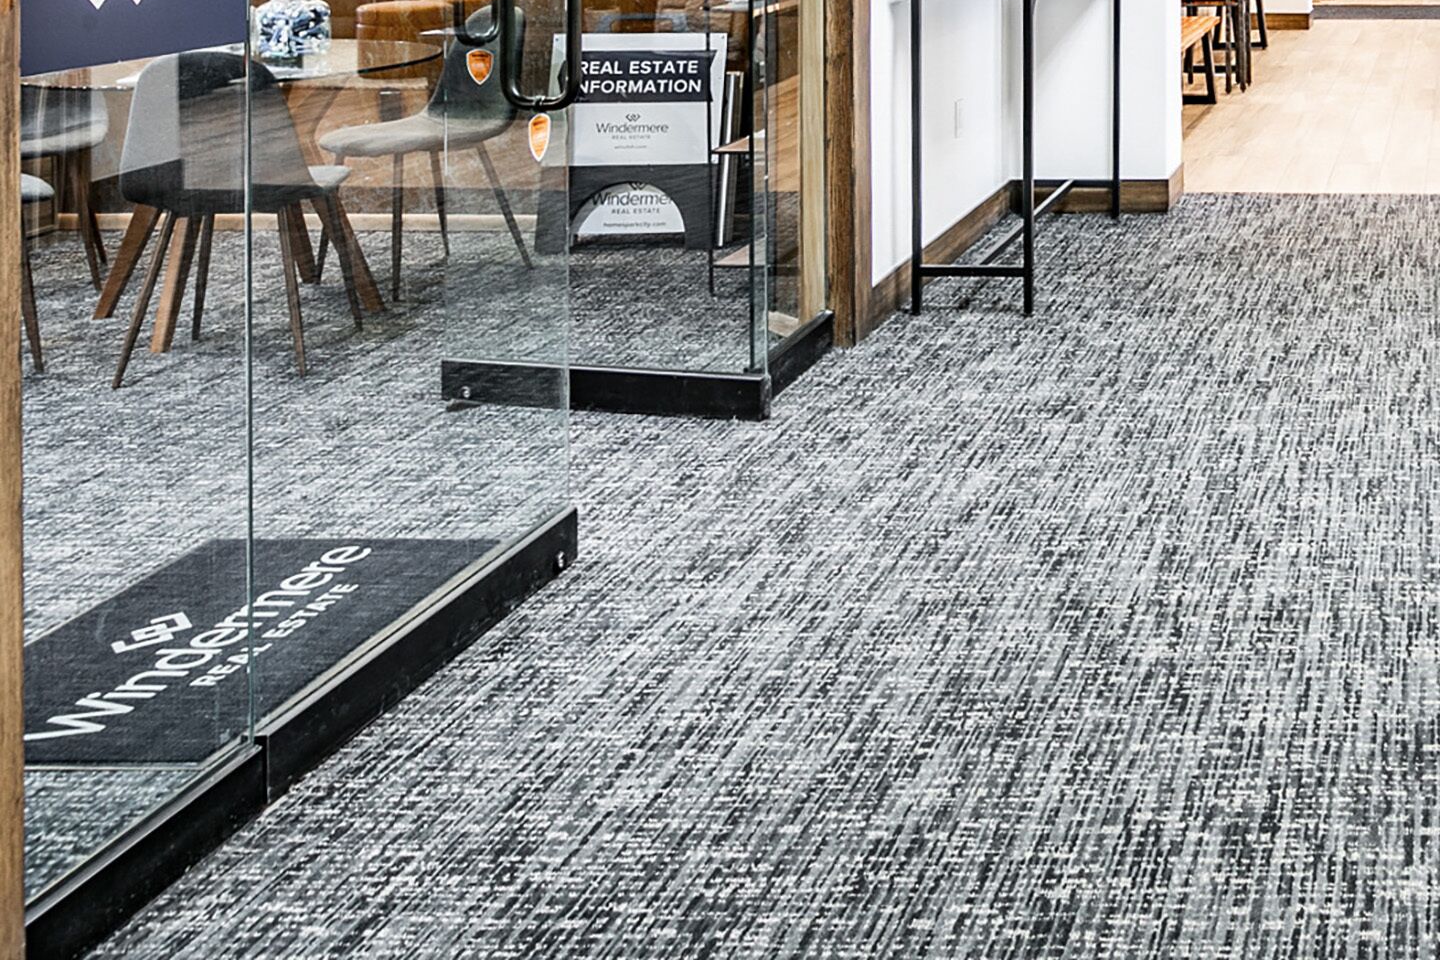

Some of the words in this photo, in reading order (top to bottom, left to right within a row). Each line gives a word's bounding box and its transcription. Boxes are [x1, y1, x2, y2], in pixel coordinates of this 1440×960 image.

[581, 60, 624, 75] REAL
[629, 60, 699, 74] ESTATE
[580, 79, 702, 94] NFORMATION
[596, 122, 669, 134] Windermere
[592, 192, 673, 206] Windermer
[189, 642, 273, 687] REAL
[261, 583, 359, 638] ESTATE
[24, 545, 372, 741] Windermere
